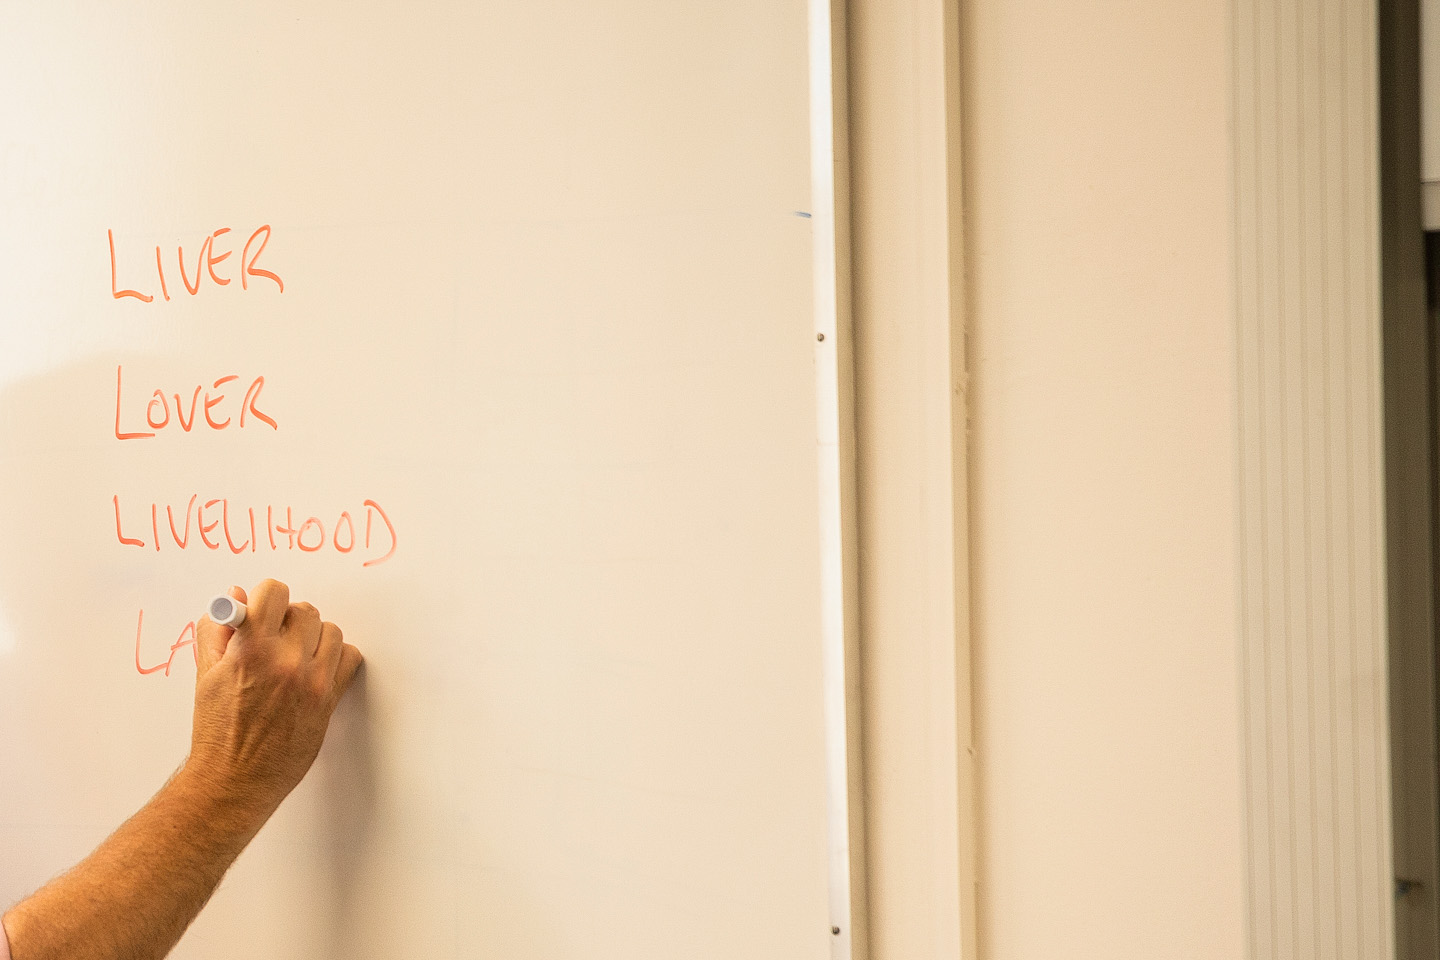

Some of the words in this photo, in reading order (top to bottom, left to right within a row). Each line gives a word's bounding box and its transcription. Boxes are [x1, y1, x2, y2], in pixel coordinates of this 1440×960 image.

[108, 225, 284, 302] LIVER
[115, 365, 278, 440] LOVER
[113, 494, 397, 567] LIVELIHOOD
